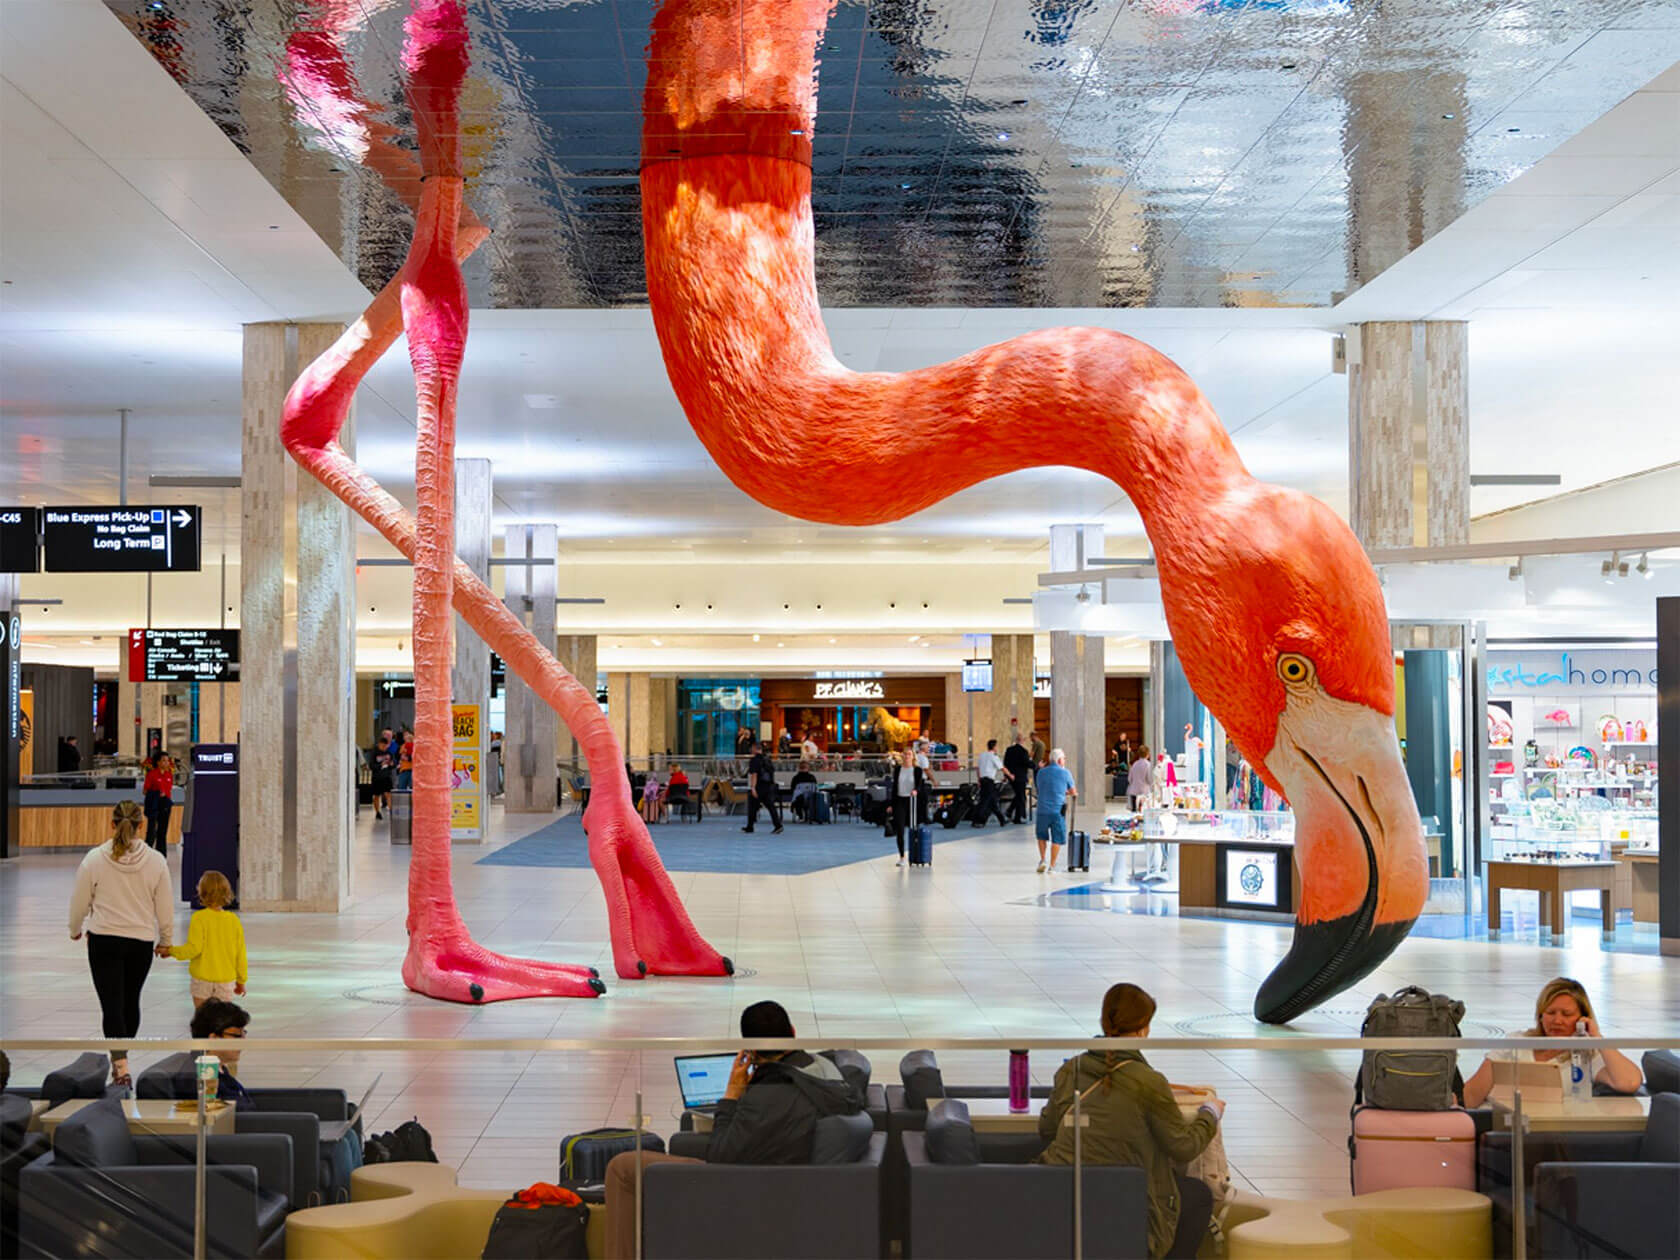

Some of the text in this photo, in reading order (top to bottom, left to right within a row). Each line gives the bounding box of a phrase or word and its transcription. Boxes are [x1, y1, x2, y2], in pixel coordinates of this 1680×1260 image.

[47, 511, 149, 525] Blue Express Pick-Up
[97, 525, 150, 535] No Bag Claim
[94, 538, 121, 550] Long
[123, 537, 150, 548] Term
